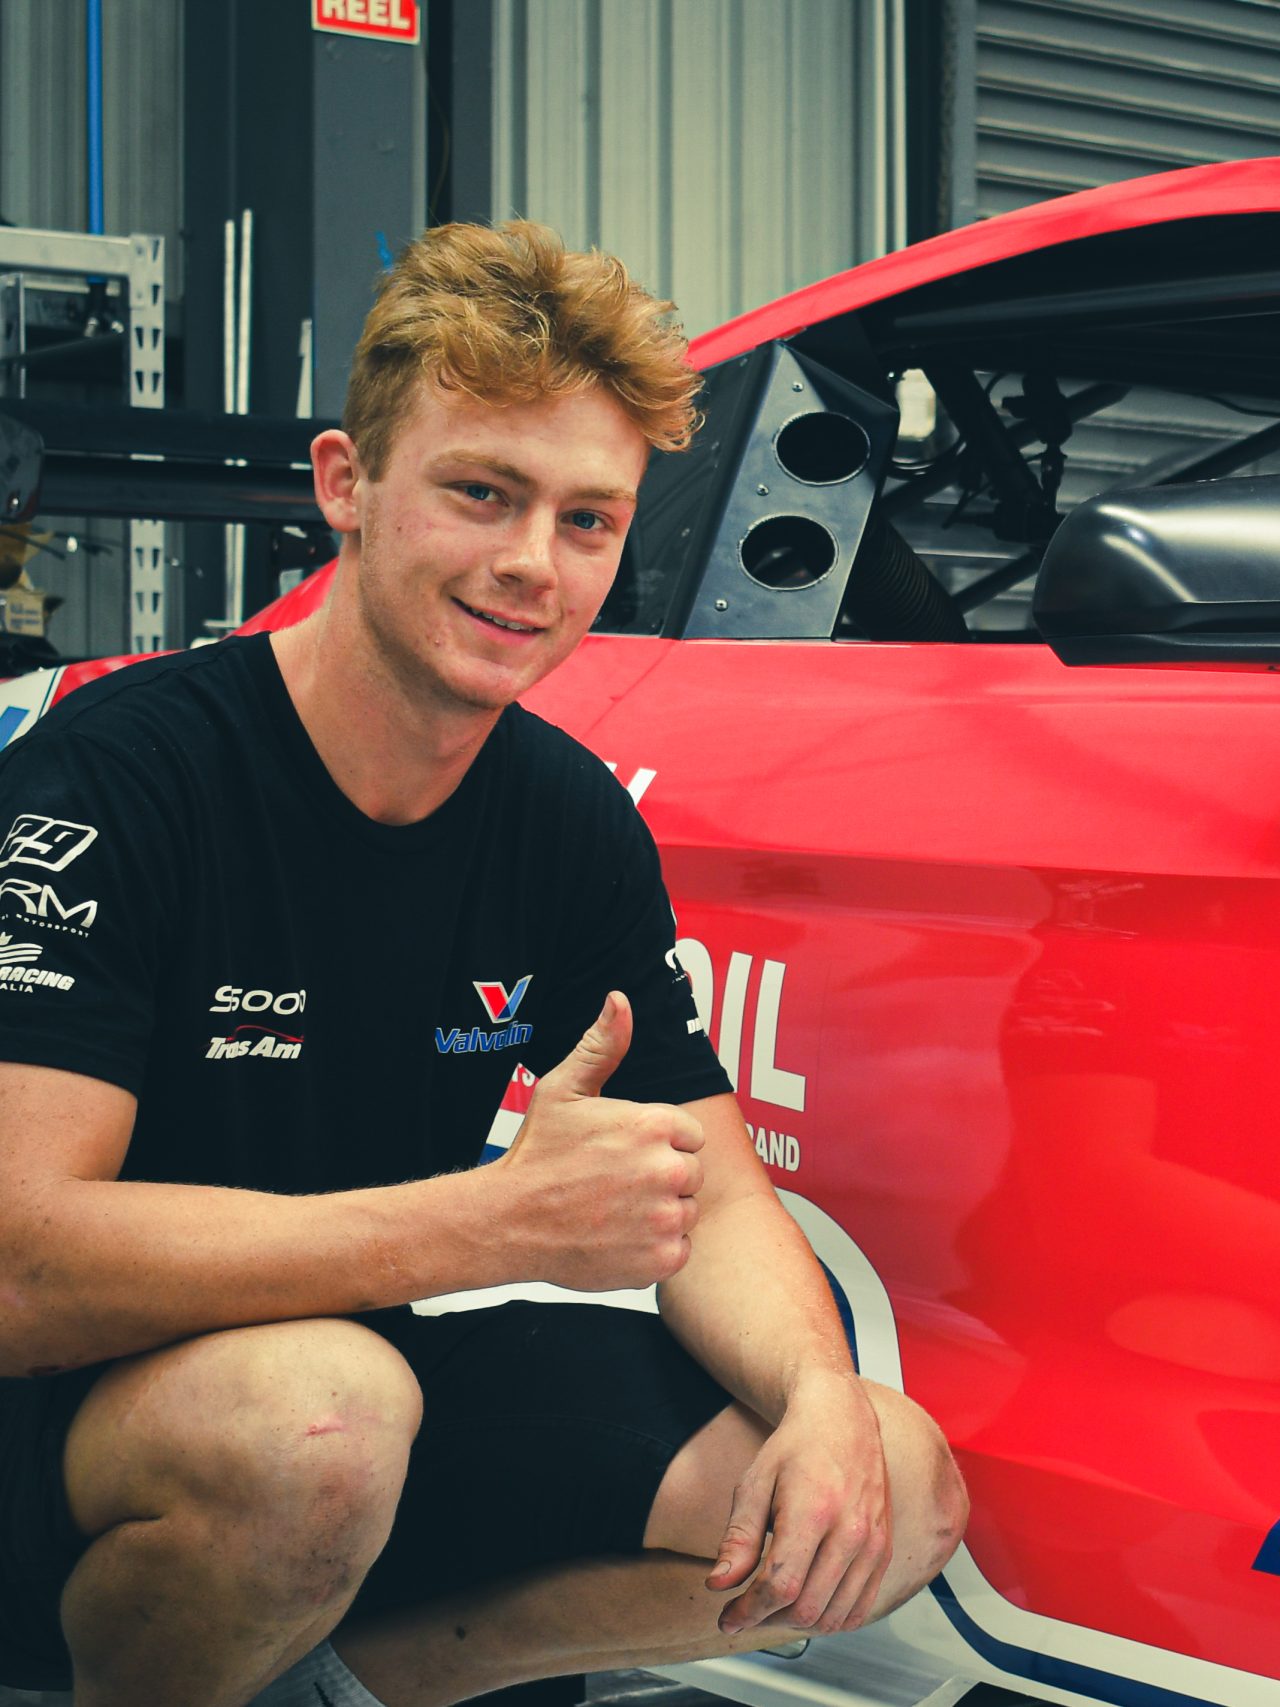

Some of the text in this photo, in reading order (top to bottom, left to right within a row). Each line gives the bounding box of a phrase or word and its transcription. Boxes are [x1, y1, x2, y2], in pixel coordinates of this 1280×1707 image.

[321, 0, 412, 30] REEL
[15, 912, 90, 938] MOTORSPORT
[248, 1036, 302, 1060] Am
[745, 1122, 800, 1172] AND
